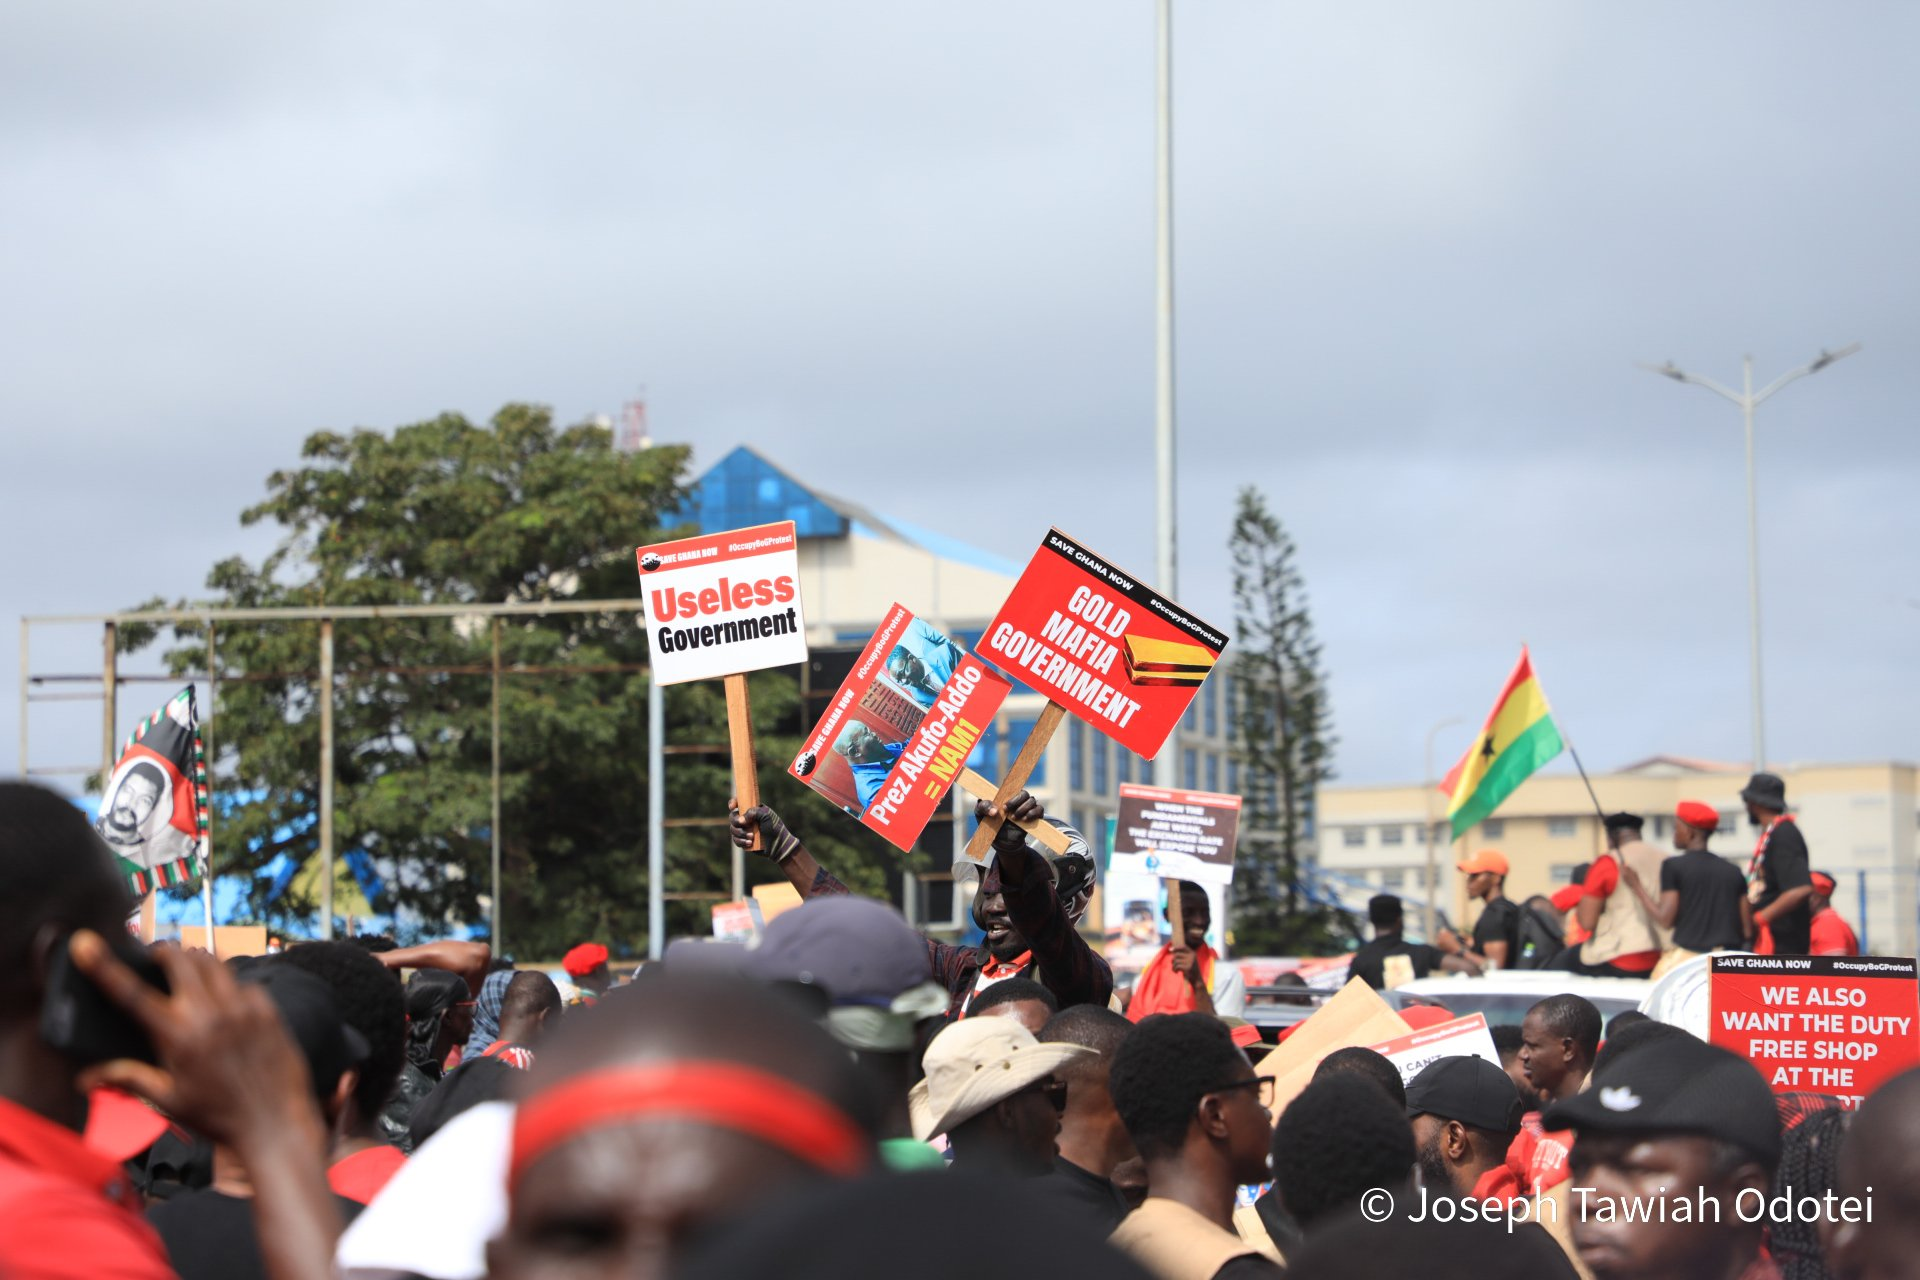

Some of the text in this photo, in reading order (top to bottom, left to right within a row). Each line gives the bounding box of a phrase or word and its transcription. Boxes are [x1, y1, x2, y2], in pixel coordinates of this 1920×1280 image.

[660, 547, 718, 565] SAVE GHANA NOW
[729, 535, 792, 552] #OccupyBoGProtest
[1050, 537, 1134, 591] SAVE GHANA NOW
[651, 575, 795, 622] Useless
[1067, 585, 1131, 638] GOLD
[658, 607, 797, 654] Government
[857, 608, 906, 680] #OccupyBoGProtest
[1040, 610, 1119, 675] MAFIA
[1150, 598, 1223, 647] #OccupyBoGProtest
[990, 622, 1142, 729] GOVERNMENT
[809, 688, 855, 756] SAVE GHANA NOW
[869, 666, 981, 826] Prez Akufo-Addo
[928, 717, 981, 784] NAM1
[1185, 805, 1204, 816] THE
[1717, 958, 1811, 969] SAVE GHANA NOW
[1833, 962, 1913, 972] #OccupyBoGProtest
[1761, 986, 1866, 1007] WE ALSO
[1721, 1011, 1911, 1036] WANT THE DUTY
[1749, 1039, 1878, 1061] FREE SHOP
[1771, 1067, 1854, 1087] AT THE
